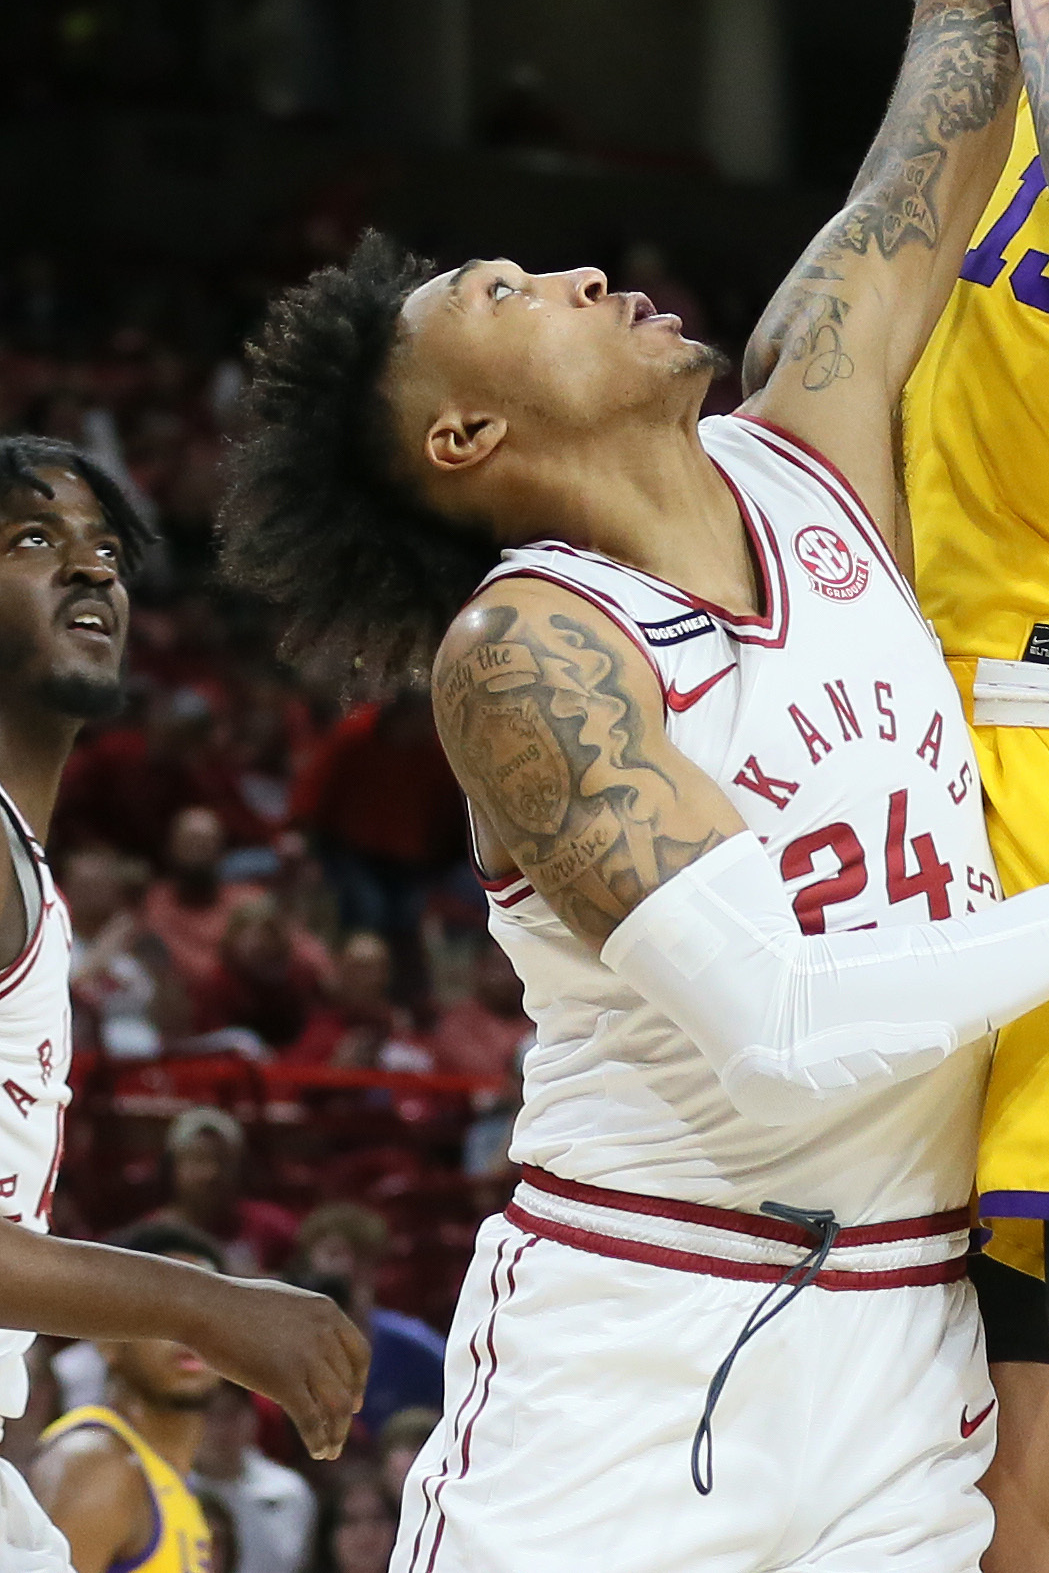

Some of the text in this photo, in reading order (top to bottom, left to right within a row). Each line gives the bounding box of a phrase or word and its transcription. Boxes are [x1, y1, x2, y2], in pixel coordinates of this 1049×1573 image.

[799, 526, 854, 581] SEC
[826, 571, 867, 599] GRADUATE
[644, 614, 711, 641] TOGETHER
[477, 645, 512, 671] the
[780, 788, 954, 936] 24
